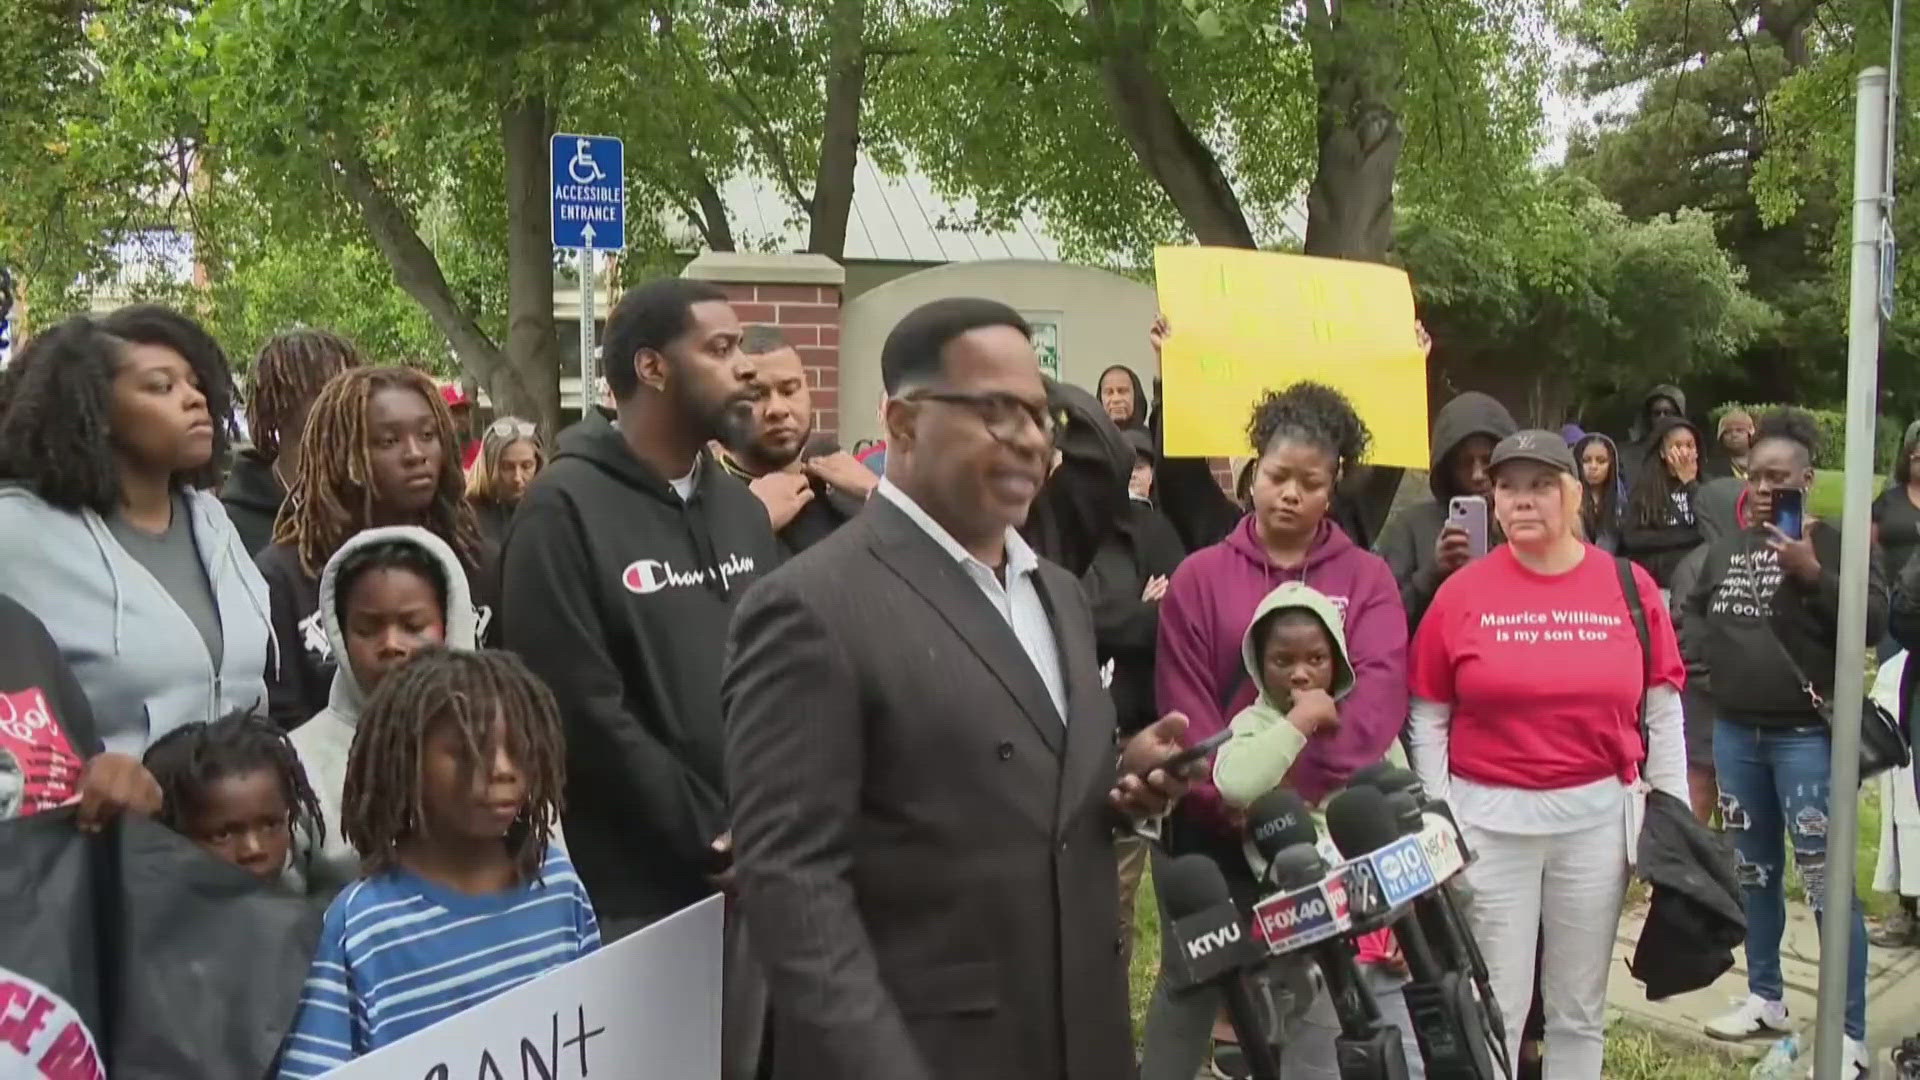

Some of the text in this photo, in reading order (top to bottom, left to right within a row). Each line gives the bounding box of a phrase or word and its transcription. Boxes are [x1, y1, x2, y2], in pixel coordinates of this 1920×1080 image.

[555, 184, 621, 203] ACCESSIBLE
[560, 204, 616, 221] ENTRANCE
[1480, 609, 1622, 628] Maurice Williams
[1514, 630, 1539, 644] my
[1544, 630, 1574, 642] son
[1578, 628, 1608, 642] too
[1387, 866, 1429, 897] NEWS
[1263, 898, 1327, 934] FOX40
[1187, 921, 1241, 960] KTVU
